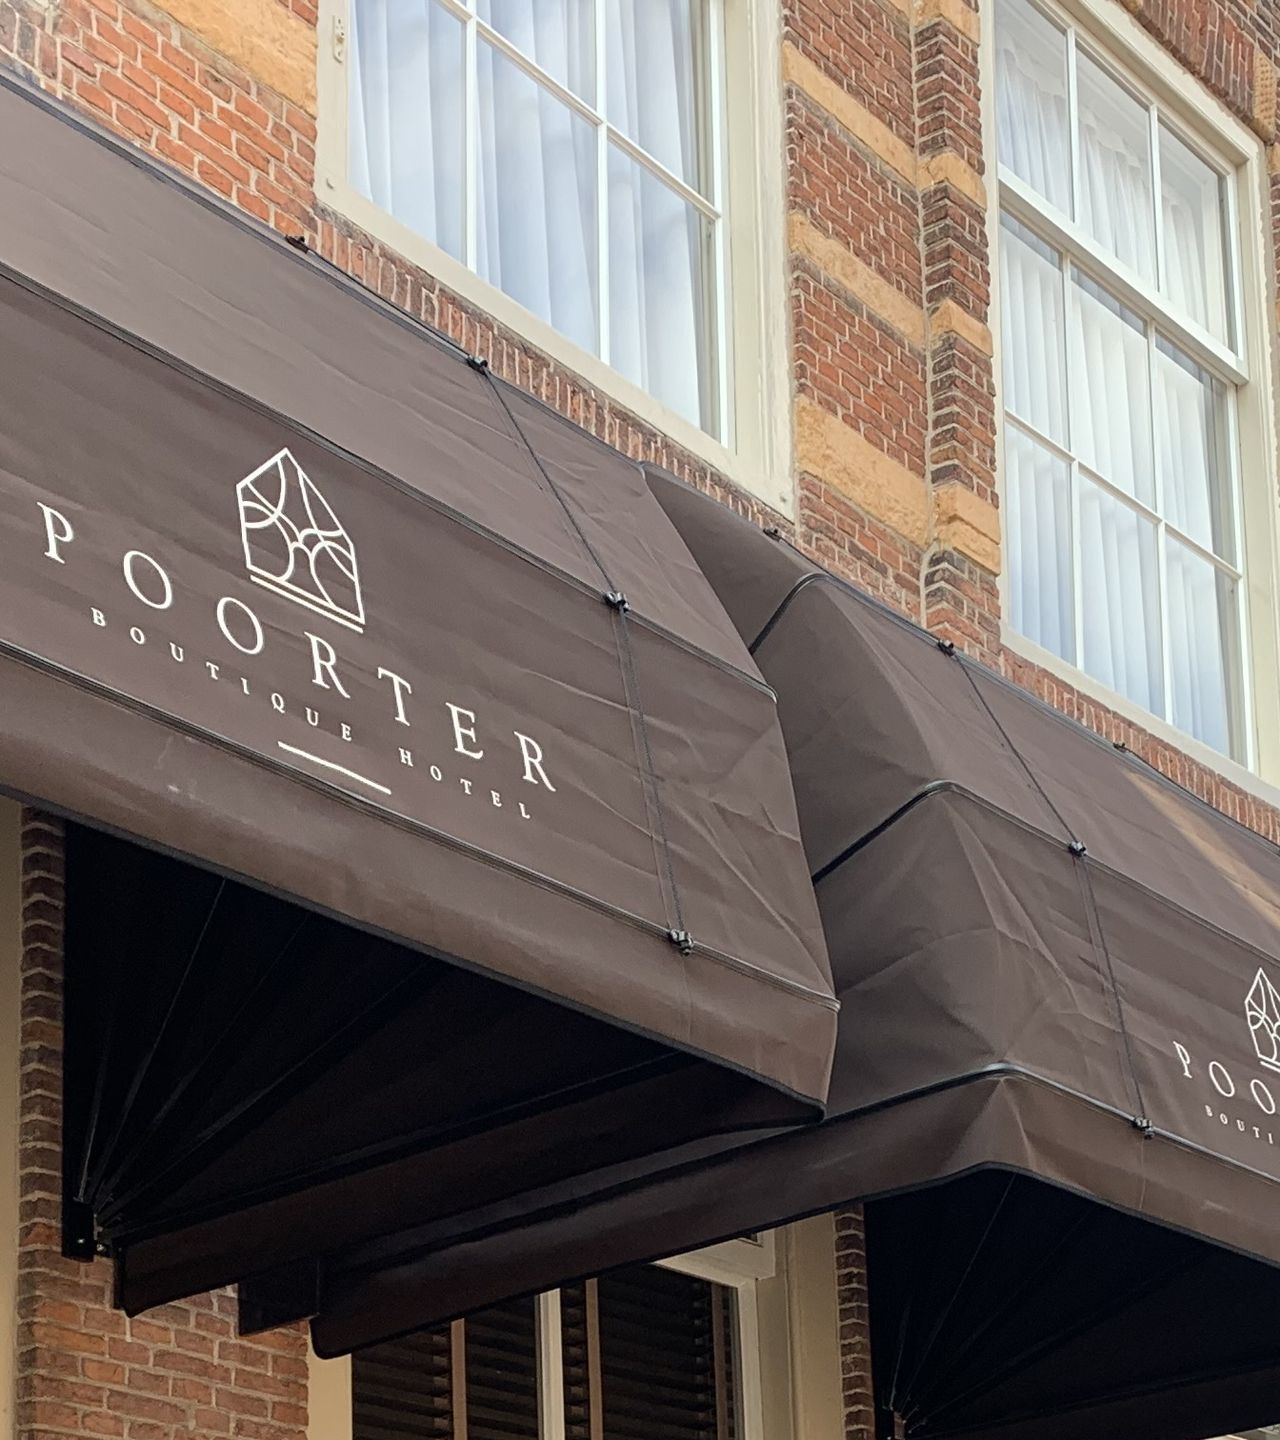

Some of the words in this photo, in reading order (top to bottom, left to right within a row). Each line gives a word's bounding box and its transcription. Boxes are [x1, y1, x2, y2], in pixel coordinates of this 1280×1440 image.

[37, 501, 557, 792] POORTER
[90, 606, 352, 742] BOUTIQUE
[399, 747, 531, 820] HOTEL
